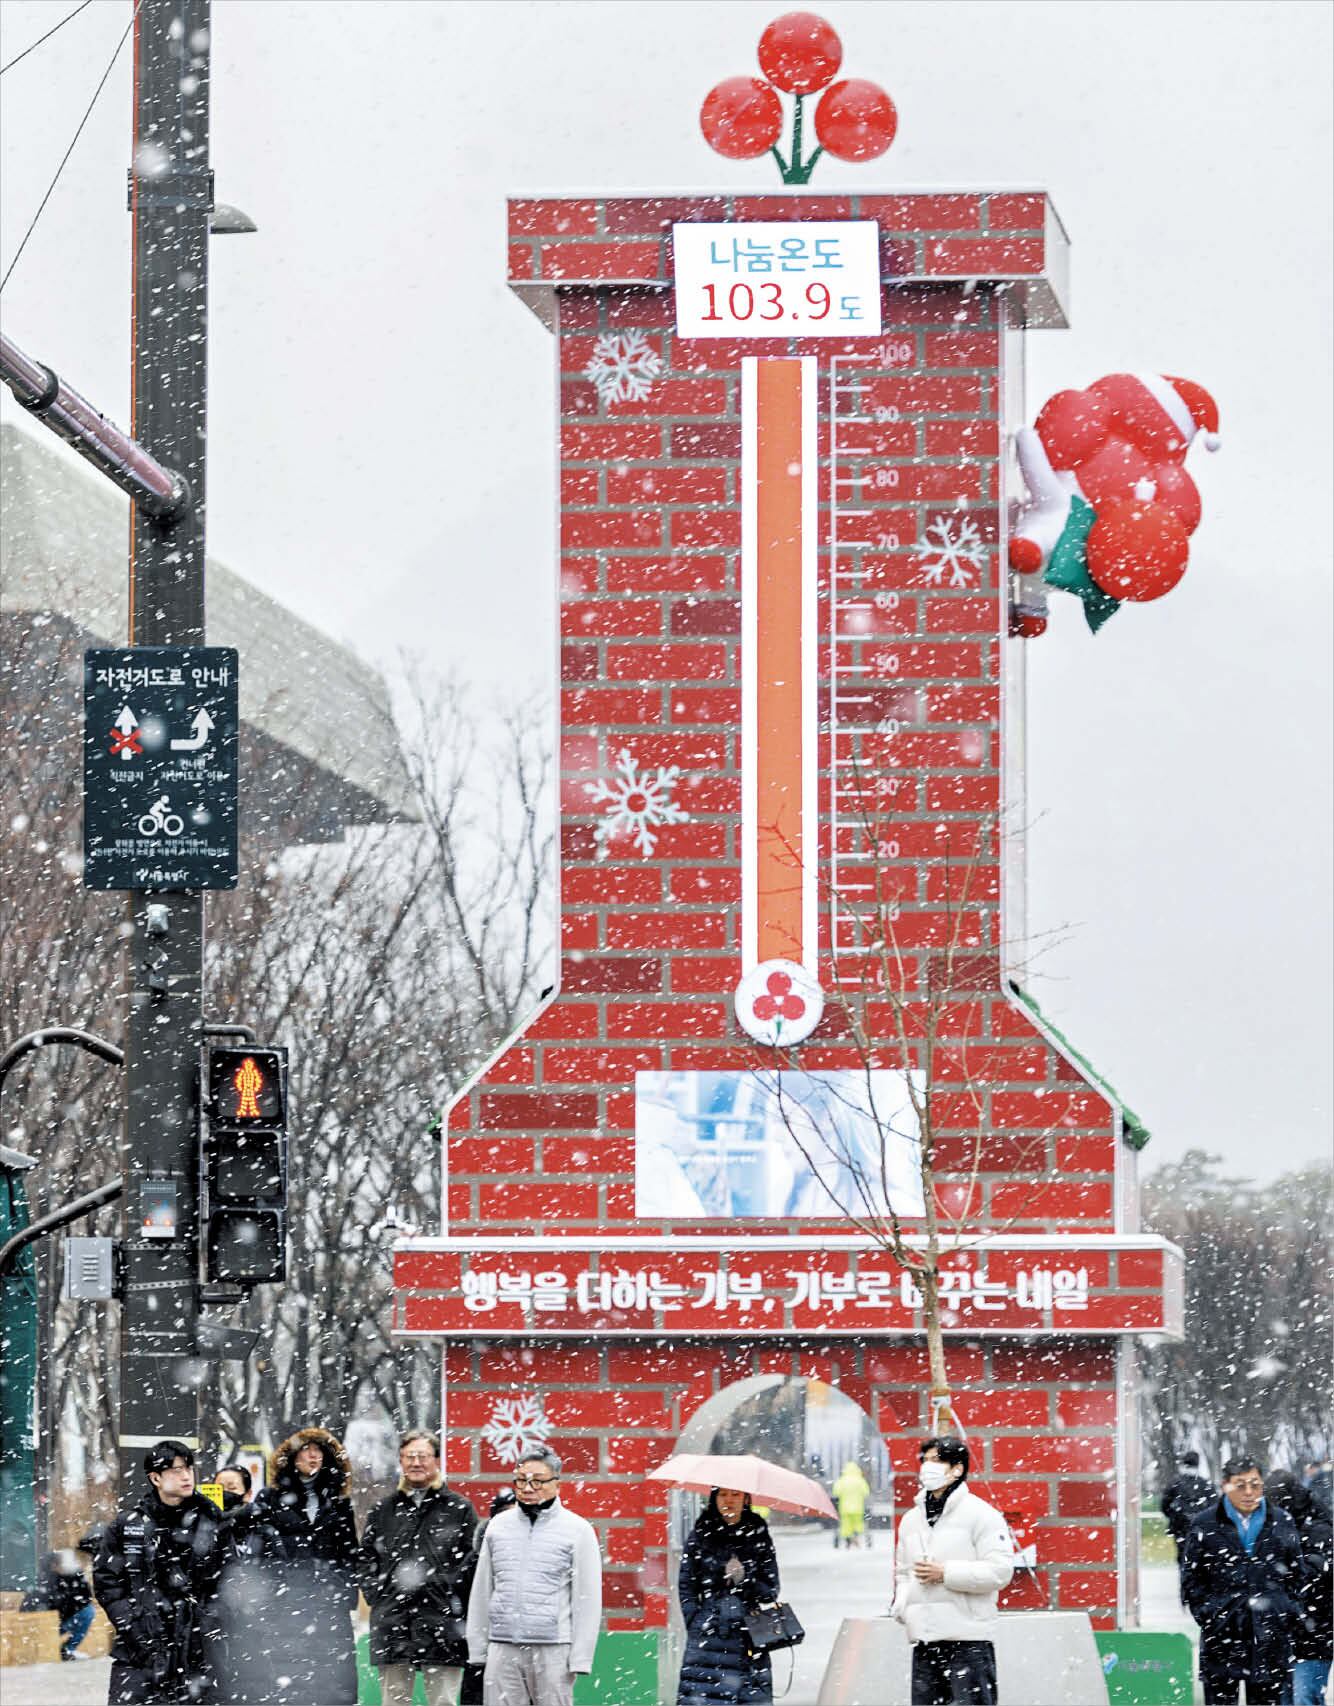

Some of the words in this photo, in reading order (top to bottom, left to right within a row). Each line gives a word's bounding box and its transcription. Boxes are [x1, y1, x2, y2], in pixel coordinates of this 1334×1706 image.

[710, 237, 844, 273] 나눔온도
[701, 282, 831, 321] 103.9
[839, 296, 864, 320] 도
[879, 344, 912, 362] 100
[876, 406, 899, 422] 90
[876, 470, 899, 487] 80
[877, 534, 899, 550] 70
[876, 592, 899, 609] 60
[876, 654, 900, 673] 50
[96, 667, 186, 689] 자전거도로
[192, 667, 228, 688] 안내
[876, 718, 900, 736] 40
[877, 777, 899, 796] 30
[877, 840, 900, 858] 20
[461, 1271, 569, 1312] 행복을
[577, 1270, 687, 1312] 더하는
[691, 1270, 774, 1313] 기부,
[784, 1271, 894, 1311] 기부로
[1016, 1268, 1090, 1311] 내일
